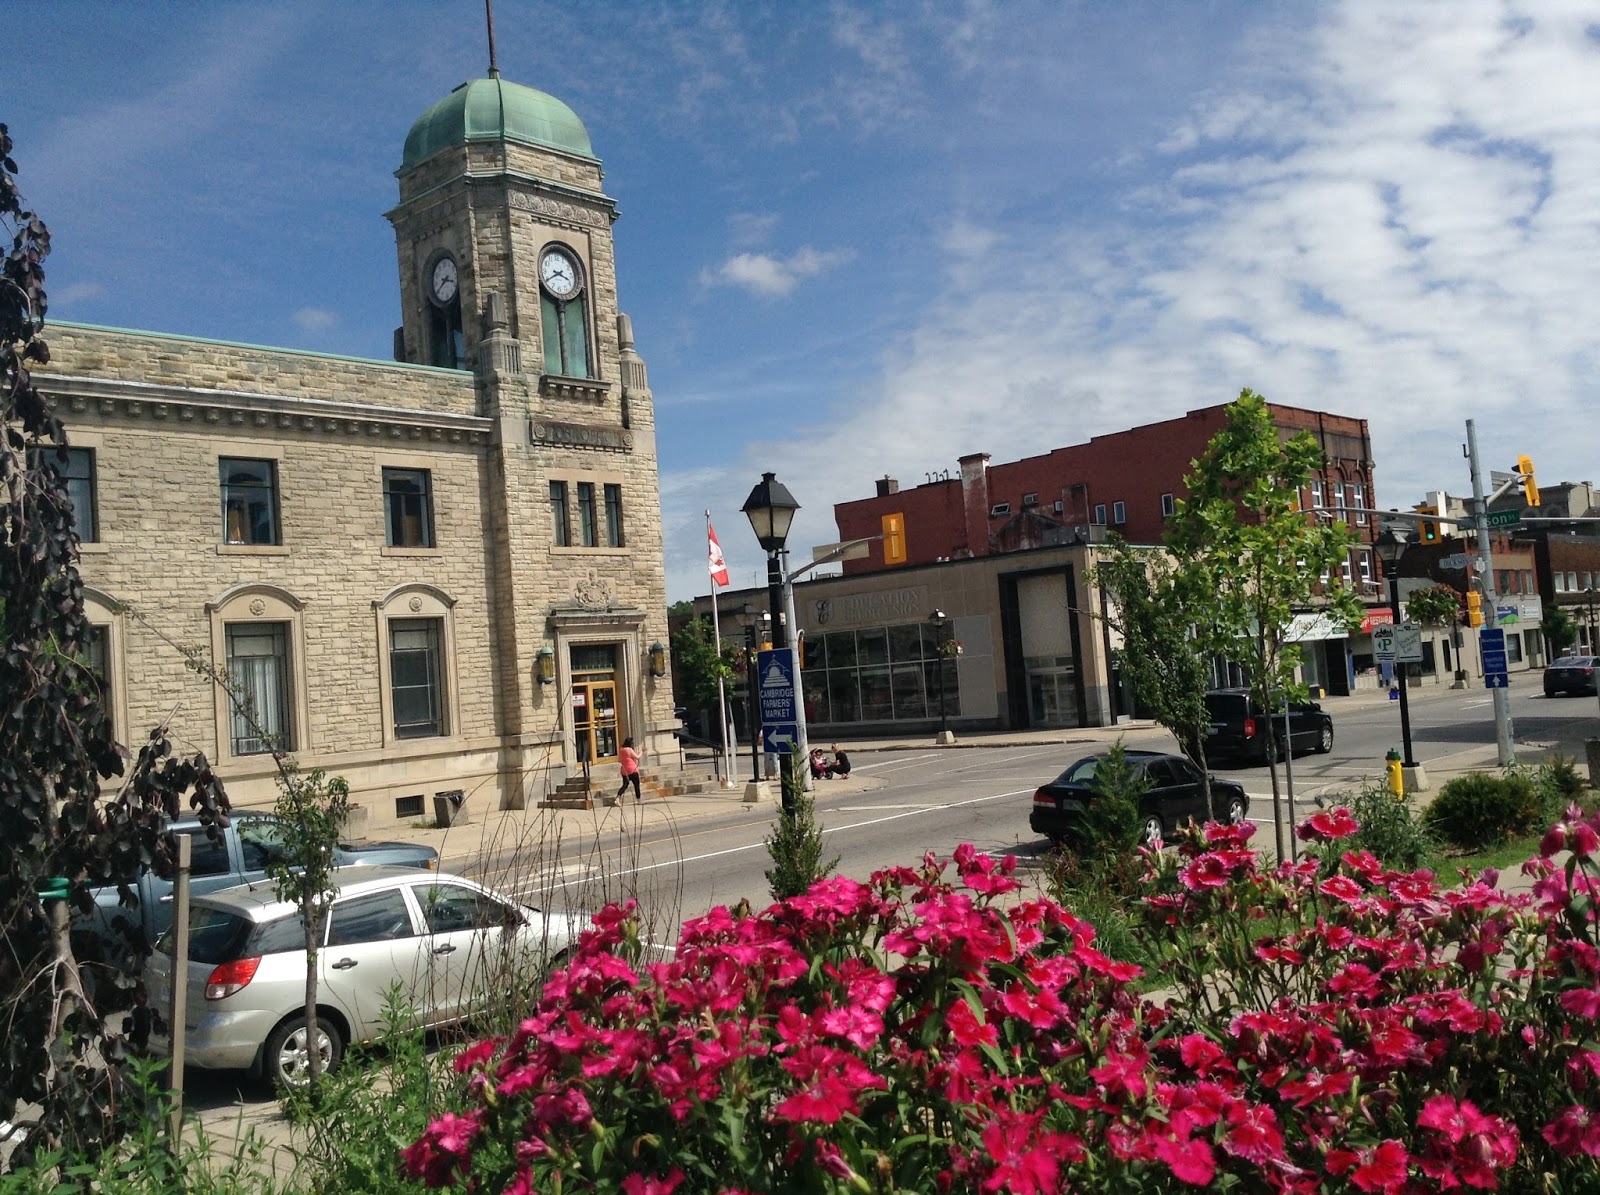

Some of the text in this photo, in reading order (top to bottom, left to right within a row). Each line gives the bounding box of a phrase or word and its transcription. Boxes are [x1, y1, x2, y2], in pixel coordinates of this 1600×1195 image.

[546, 426, 619, 446] POST OFFICE
[842, 590, 920, 610] EDUCATION
[885, 604, 920, 618] UNION
[1381, 638, 1392, 651] P
[760, 688, 794, 699] CAMBRIDGE
[765, 708, 790, 718] MARKET
